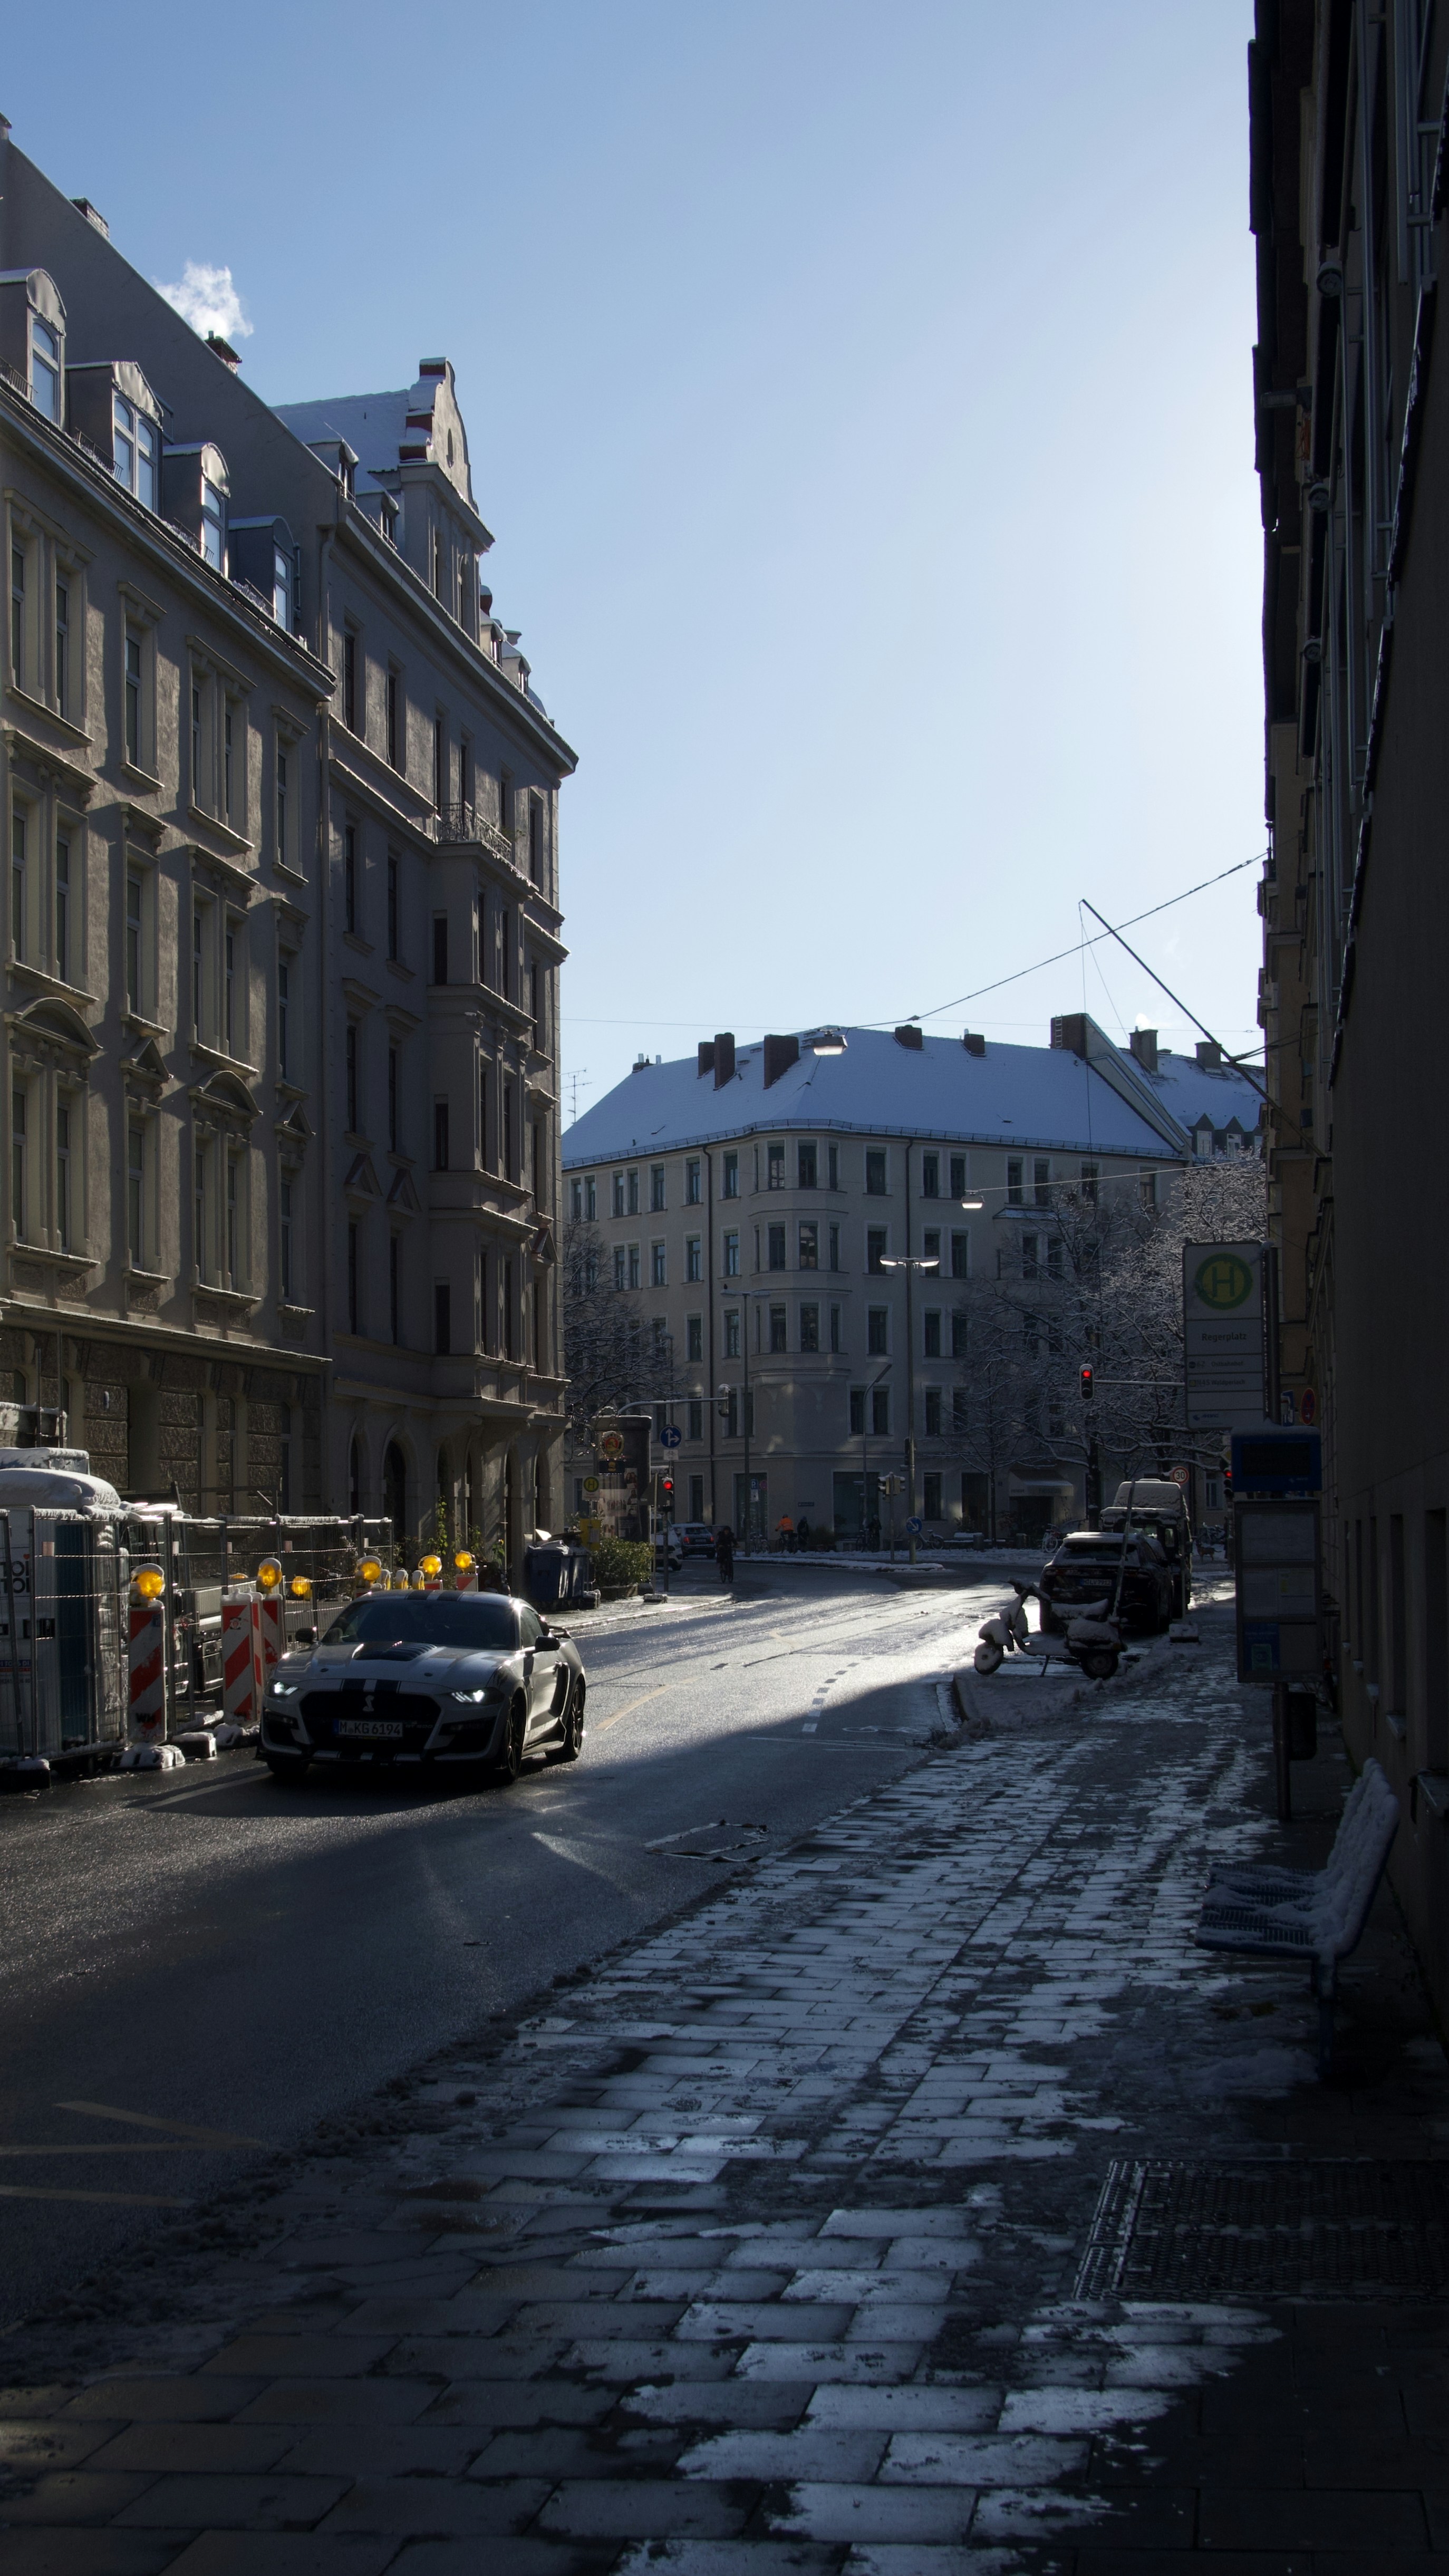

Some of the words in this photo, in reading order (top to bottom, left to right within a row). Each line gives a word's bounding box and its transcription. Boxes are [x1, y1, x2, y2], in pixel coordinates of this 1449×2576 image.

[1212, 1266, 1235, 1297] H
[1201, 1333, 1247, 1343] Regerplatz
[587, 1479, 594, 1489] H
[340, 1721, 346, 1733] M
[354, 1722, 369, 1734] KG
[372, 1723, 401, 1735] 6194
